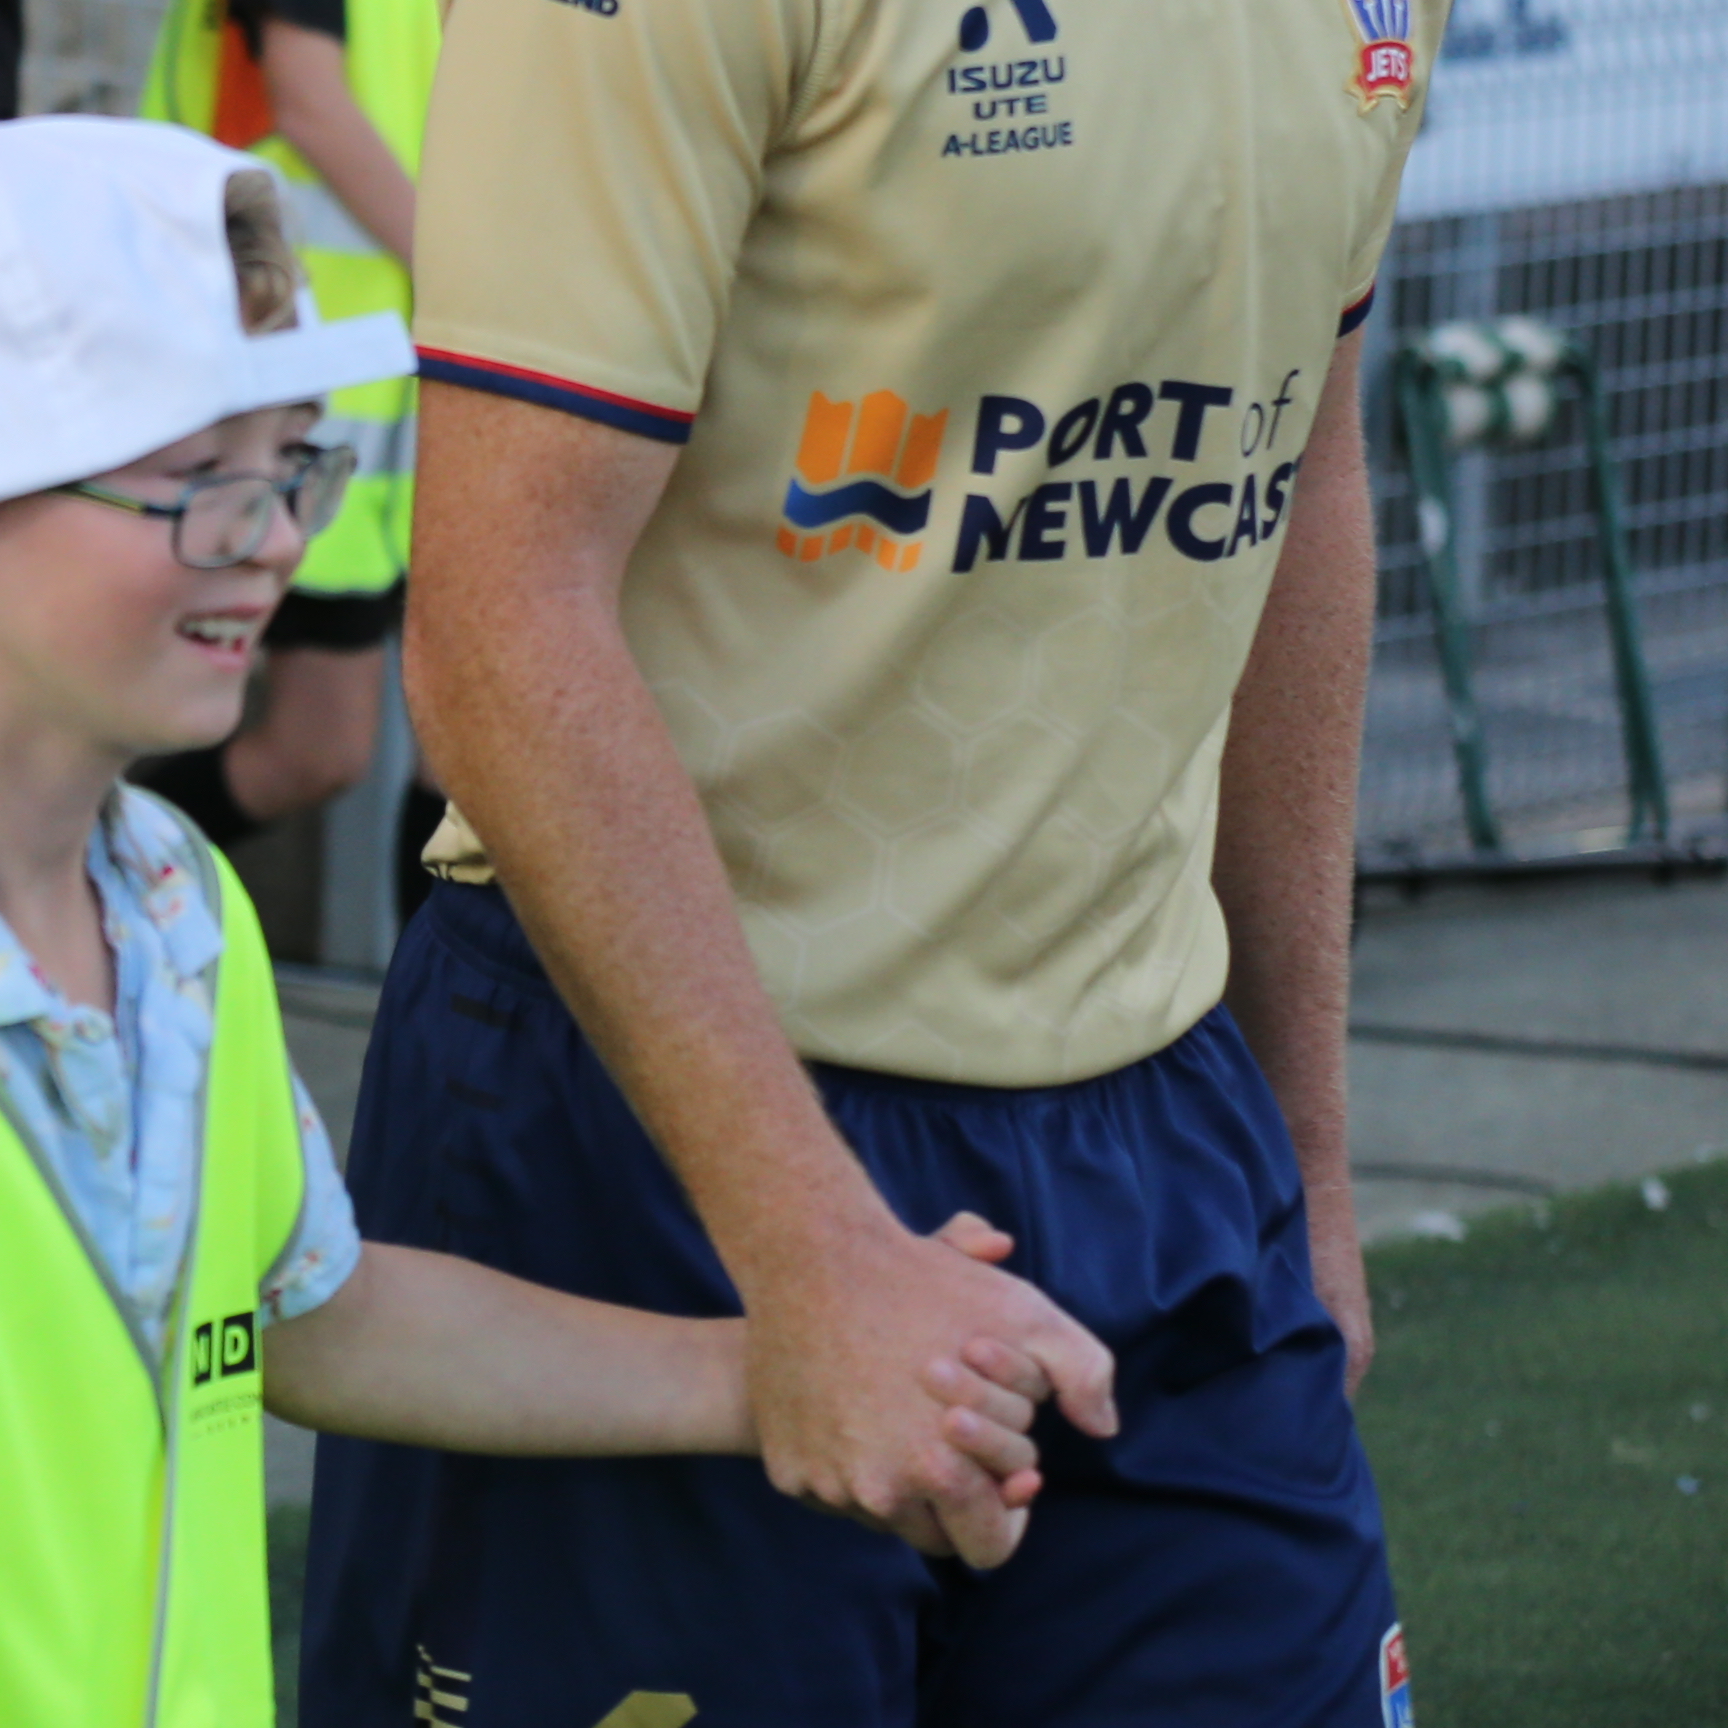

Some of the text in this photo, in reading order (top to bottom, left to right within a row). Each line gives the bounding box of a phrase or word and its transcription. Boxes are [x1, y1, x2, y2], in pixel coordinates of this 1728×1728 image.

[948, 56, 1066, 94] ISUZU
[1367, 47, 1408, 82] JETS
[974, 95, 1047, 121] UTE
[942, 121, 1074, 157] A-LEAGUE
[971, 369, 1300, 477] PORT of
